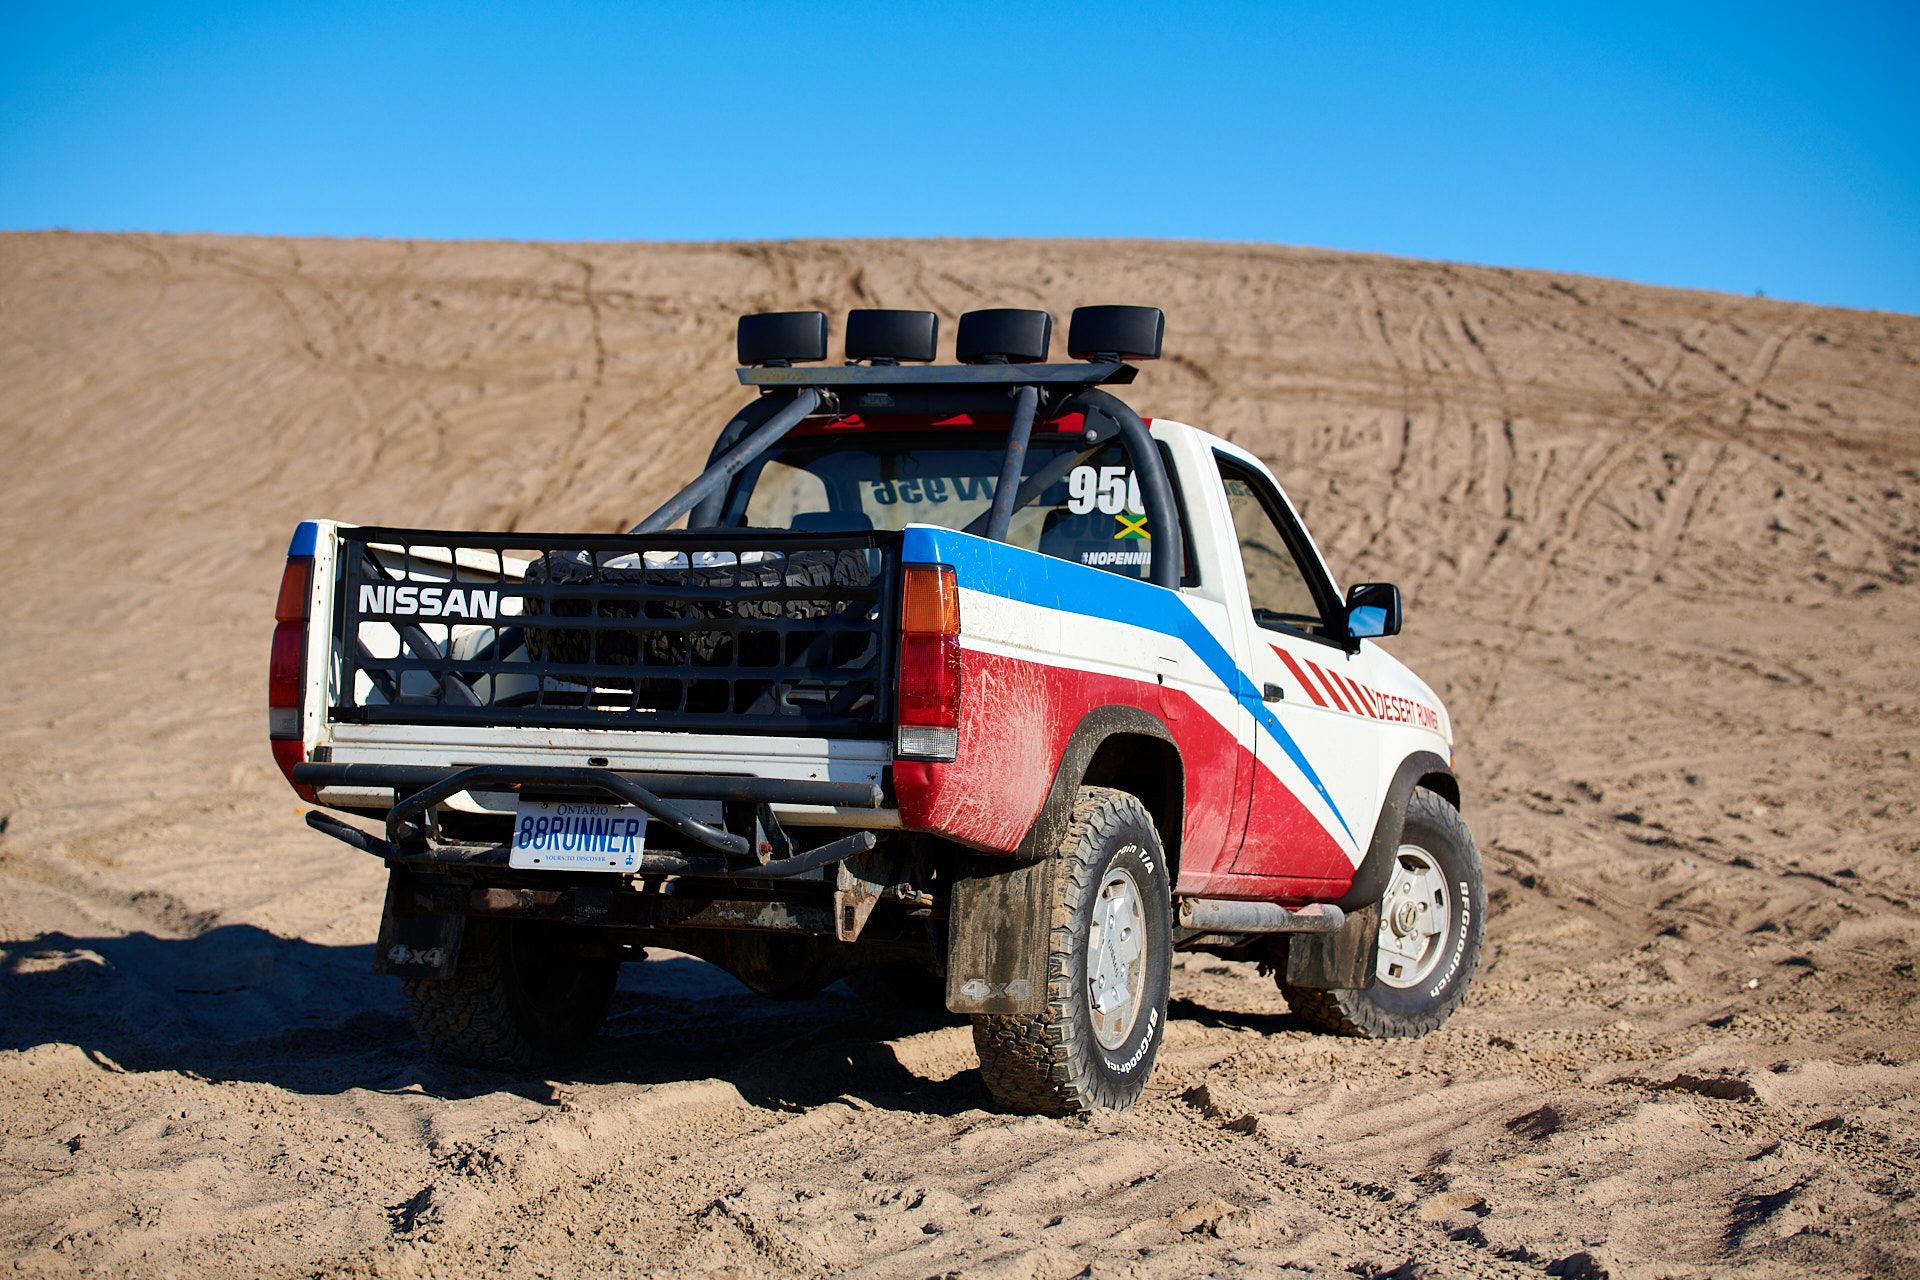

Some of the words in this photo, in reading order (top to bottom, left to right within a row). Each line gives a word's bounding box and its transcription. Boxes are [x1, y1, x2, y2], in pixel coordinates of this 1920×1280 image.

[358, 584, 498, 619] NISSAN
[1375, 691, 1415, 724] DESERT
[557, 804, 608, 816] ONTARIO
[518, 816, 640, 852] 88RUNNER
[1138, 847, 1154, 875] T/A
[1430, 882, 1470, 998] BFGoodrich
[1104, 1007, 1159, 1074] BFGoodrich
